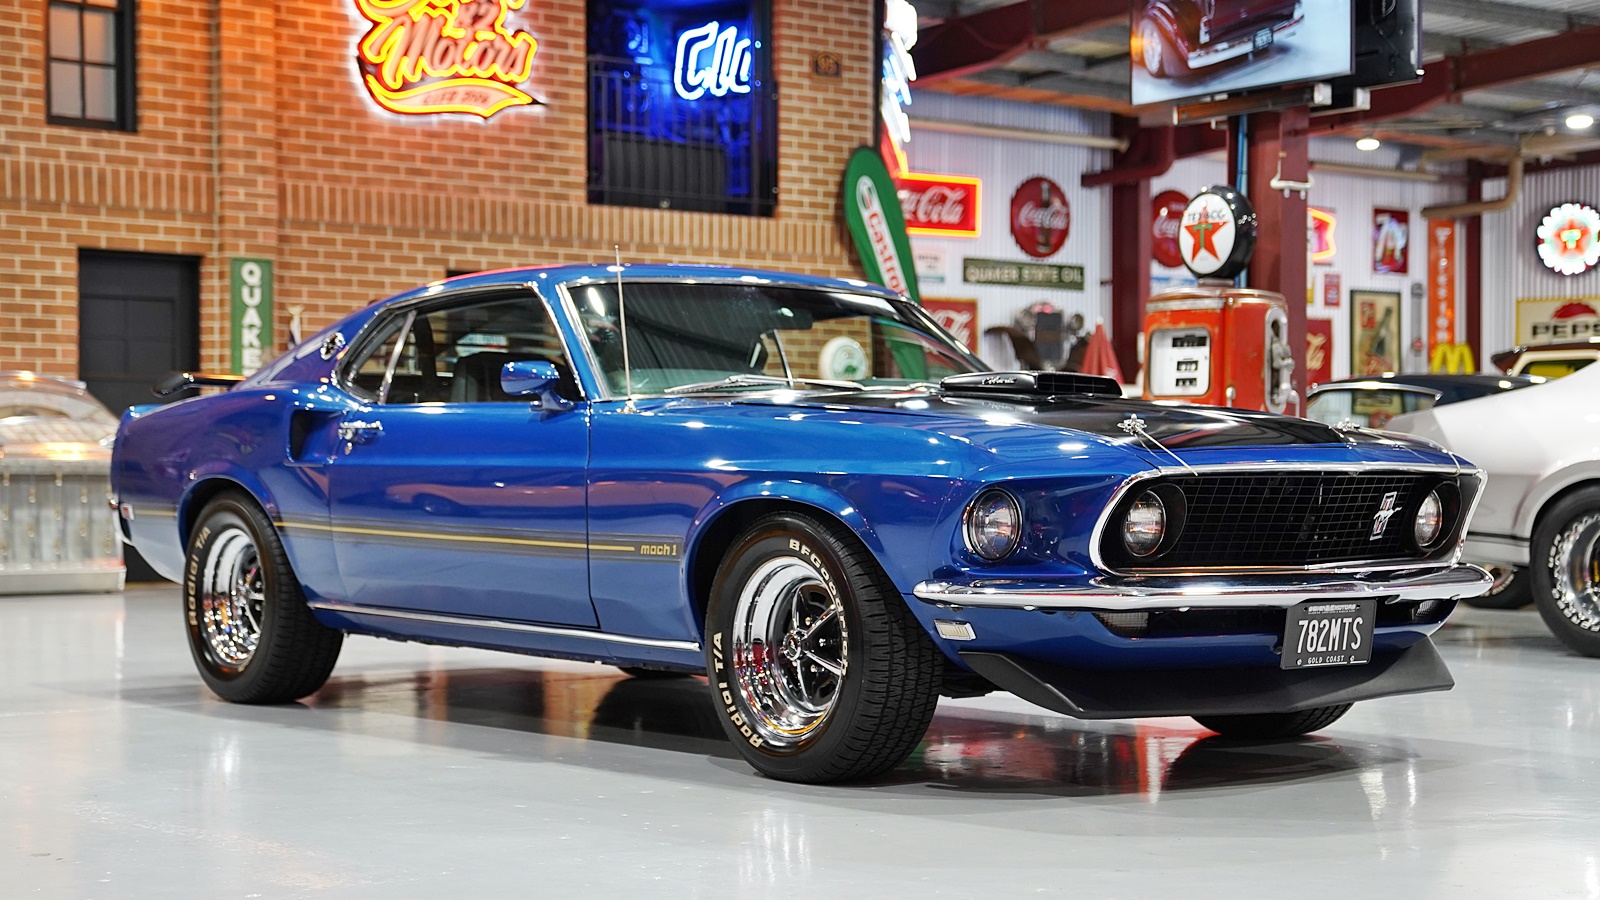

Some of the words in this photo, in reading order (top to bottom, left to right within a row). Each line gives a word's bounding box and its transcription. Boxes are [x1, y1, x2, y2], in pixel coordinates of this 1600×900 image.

[366, 14, 533, 87] Motors
[966, 265, 1020, 282] QUAKER
[1022, 267, 1059, 283] STATE
[1061, 268, 1082, 283] OIL
[641, 544, 670, 555] mach
[672, 544, 677, 555] 1
[187, 554, 200, 626] Radial
[194, 526, 212, 549] T/A
[713, 632, 723, 673] T/A
[1297, 617, 1363, 653] 782MTS
[1326, 655, 1345, 663] COAST
[718, 685, 763, 749] Radial
